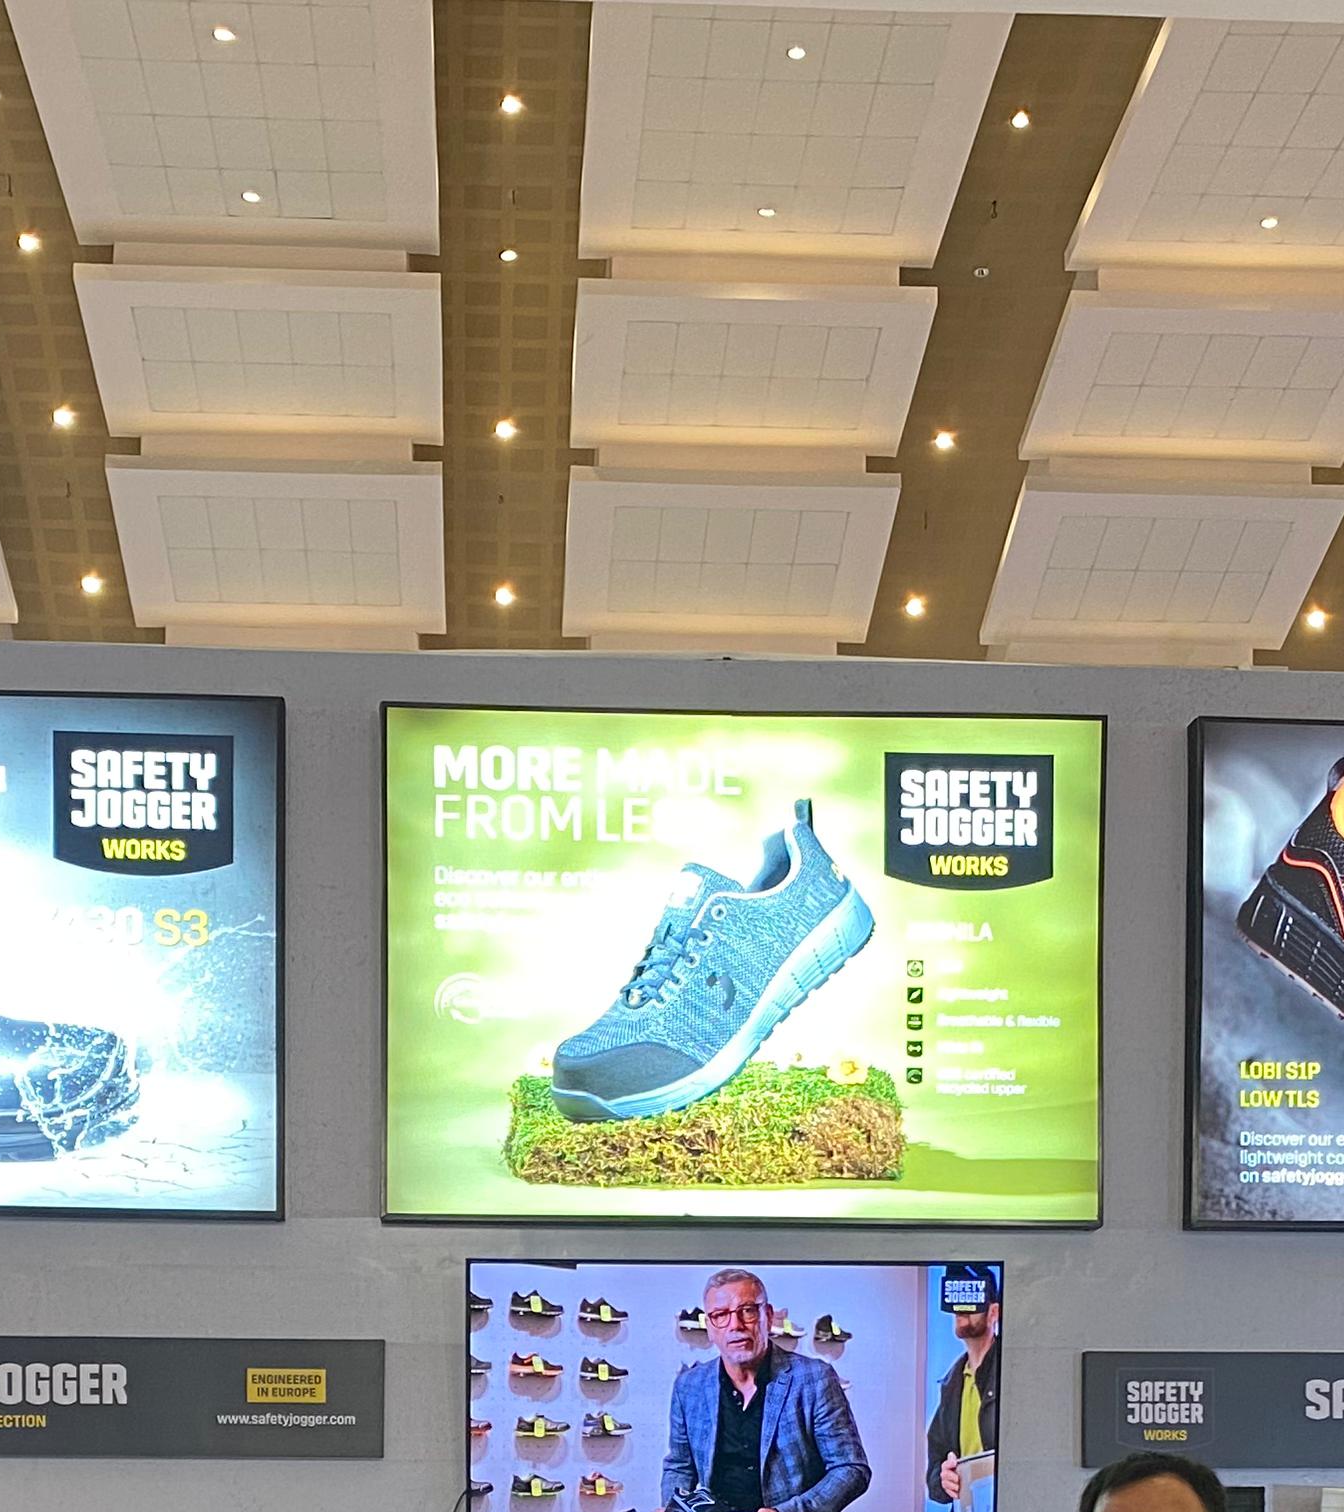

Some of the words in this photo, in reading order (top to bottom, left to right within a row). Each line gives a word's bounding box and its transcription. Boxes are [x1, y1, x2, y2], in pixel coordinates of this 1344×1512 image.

[71, 750, 217, 791] SAFETY
[433, 745, 582, 791] MORE
[597, 748, 742, 796] MADE
[900, 769, 1038, 808] SAFETY
[71, 789, 217, 830] JOGGER
[434, 794, 583, 841] FROM
[900, 808, 1038, 846] JOGGER
[102, 838, 186, 861] WORKS
[929, 855, 1009, 876] WORKS
[155, 908, 208, 947] S3
[1240, 1061, 1281, 1080] LOBI
[1285, 1061, 1321, 1080] S1P
[1240, 1090, 1283, 1108] LOW
[1285, 1090, 1320, 1108] TLS
[1240, 1131, 1305, 1146] Discover
[1308, 1134, 1334, 1146] our
[1240, 1149, 1327, 1167] lightweight
[1240, 1171, 1259, 1183] on
[945, 1280, 986, 1291] SAFETY
[251, 1373, 322, 1386] ENGINEERED
[257, 1387, 269, 1397] IN
[272, 1386, 316, 1398] EUROPE
[1126, 1380, 1204, 1402] SAFETY
[216, 1413, 356, 1427] www.safetyjogger.com
[1126, 1403, 1204, 1424] JOGGER
[1143, 1429, 1187, 1441] WORKS
